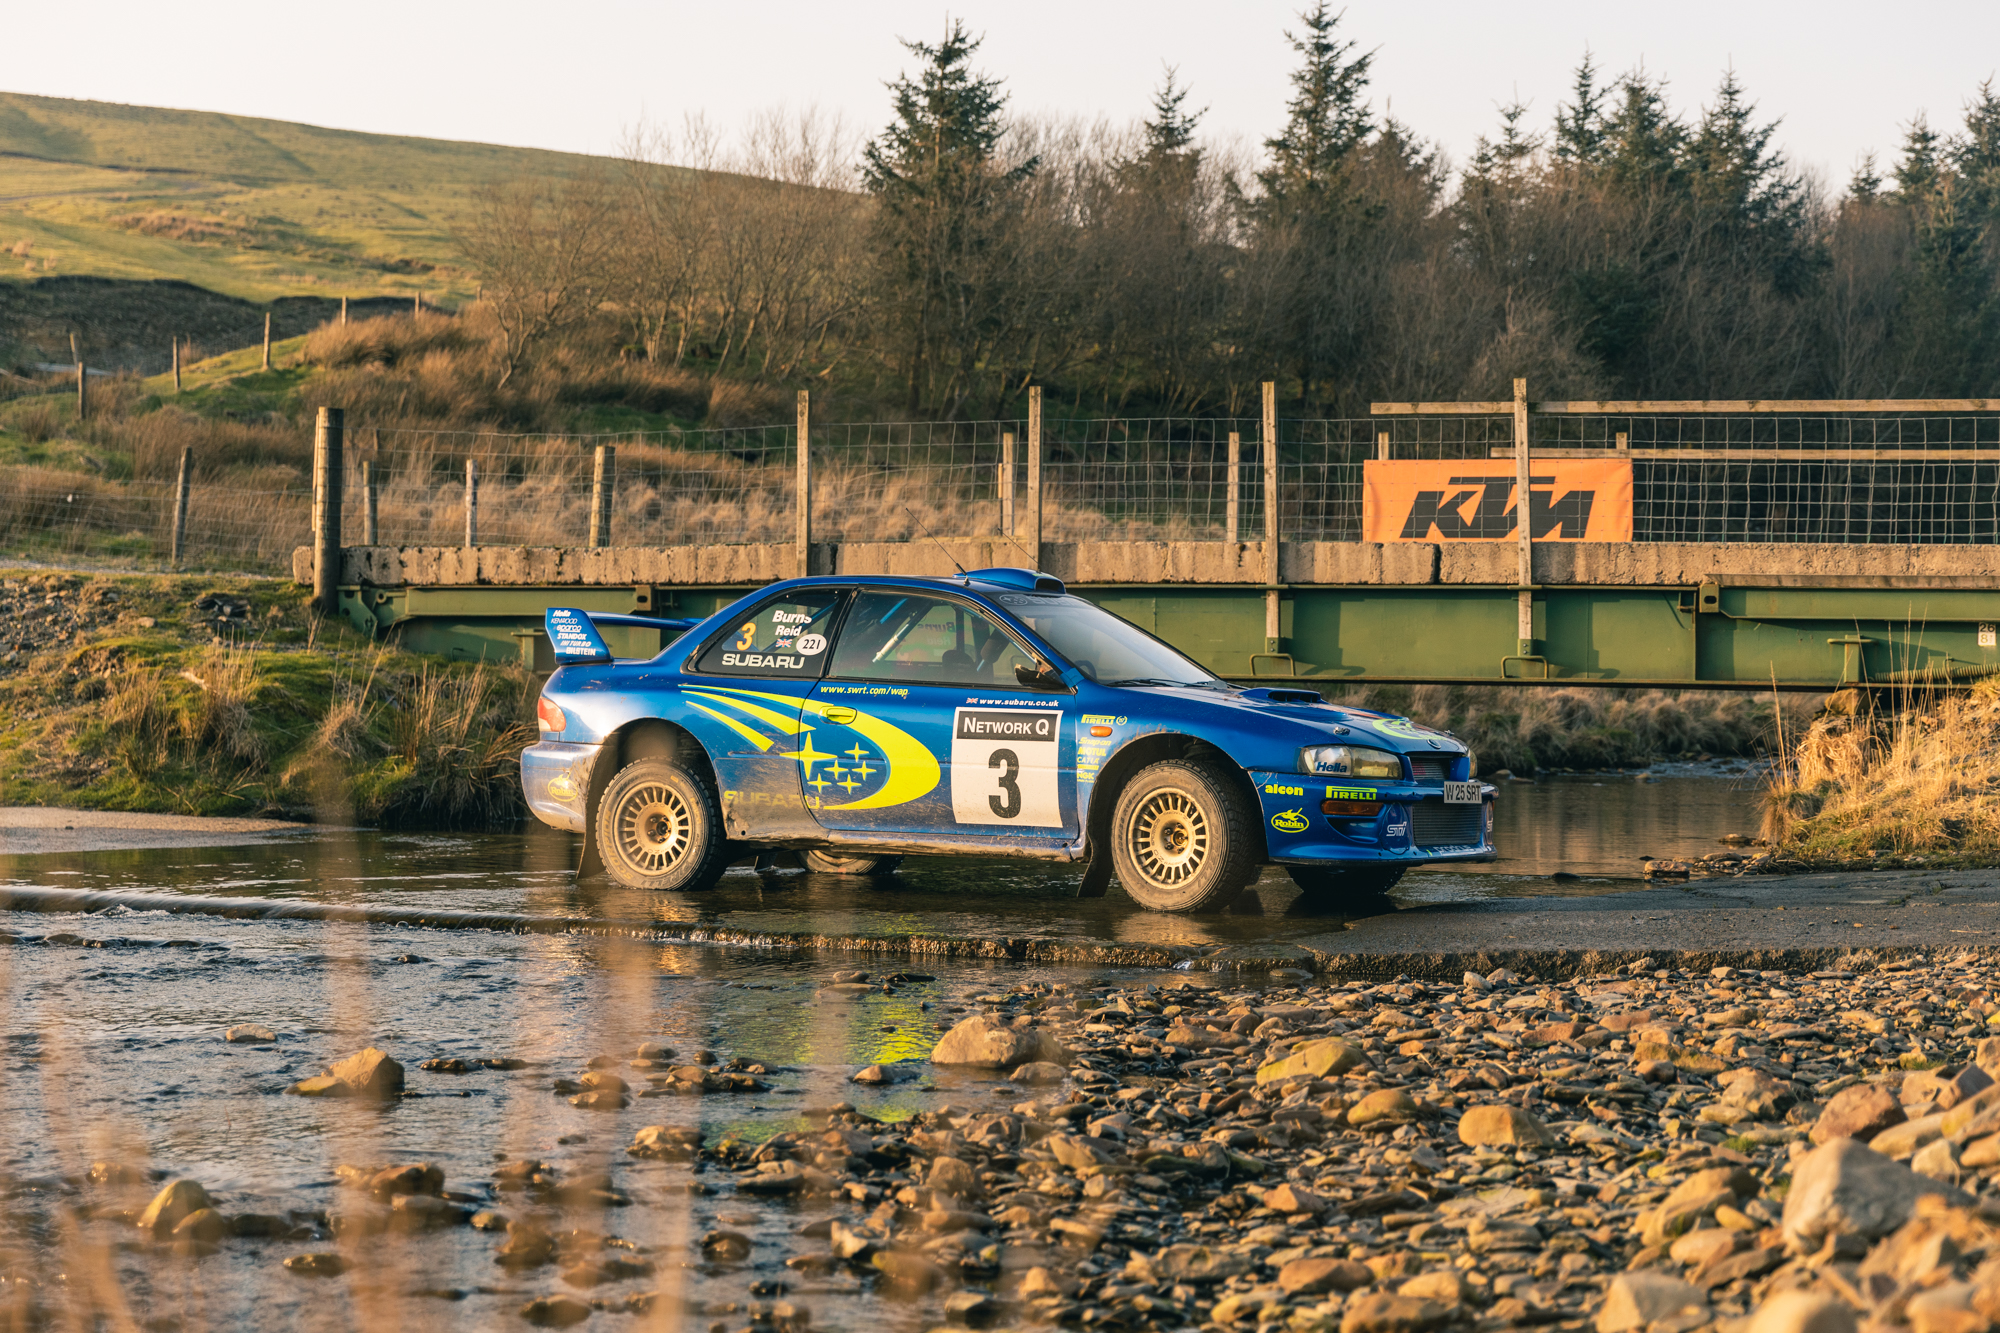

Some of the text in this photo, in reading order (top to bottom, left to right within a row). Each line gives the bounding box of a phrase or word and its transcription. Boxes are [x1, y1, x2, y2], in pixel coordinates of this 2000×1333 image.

[1399, 476, 1596, 539] KTM
[772, 610, 813, 624] Burns
[775, 625, 802, 637] Reid
[1980, 622, 1995, 632] 26
[557, 632, 588, 640] STANDOX
[736, 622, 757, 651] 3
[802, 638, 821, 650] 221
[565, 647, 597, 656] BILSTEIN
[721, 653, 805, 669] SUBARU
[820, 685, 909, 697] www.swrt.com/wap
[979, 698, 1059, 707] www.subaru.co.uk
[1080, 714, 1116, 726] PIRELLI
[1035, 718, 1050, 736] Q
[1077, 746, 1107, 757] MOTUL
[1316, 761, 1348, 773] Hella
[1077, 772, 1095, 780] NGK
[988, 748, 1022, 819] 3
[1265, 784, 1304, 796] alcon
[1325, 785, 1378, 801] PIRELLI
[1467, 784, 1481, 801] SRT
[723, 790, 820, 809] SUBARU
[1274, 818, 1305, 829] Robin
[603, 810, 634, 880] SCORPION
